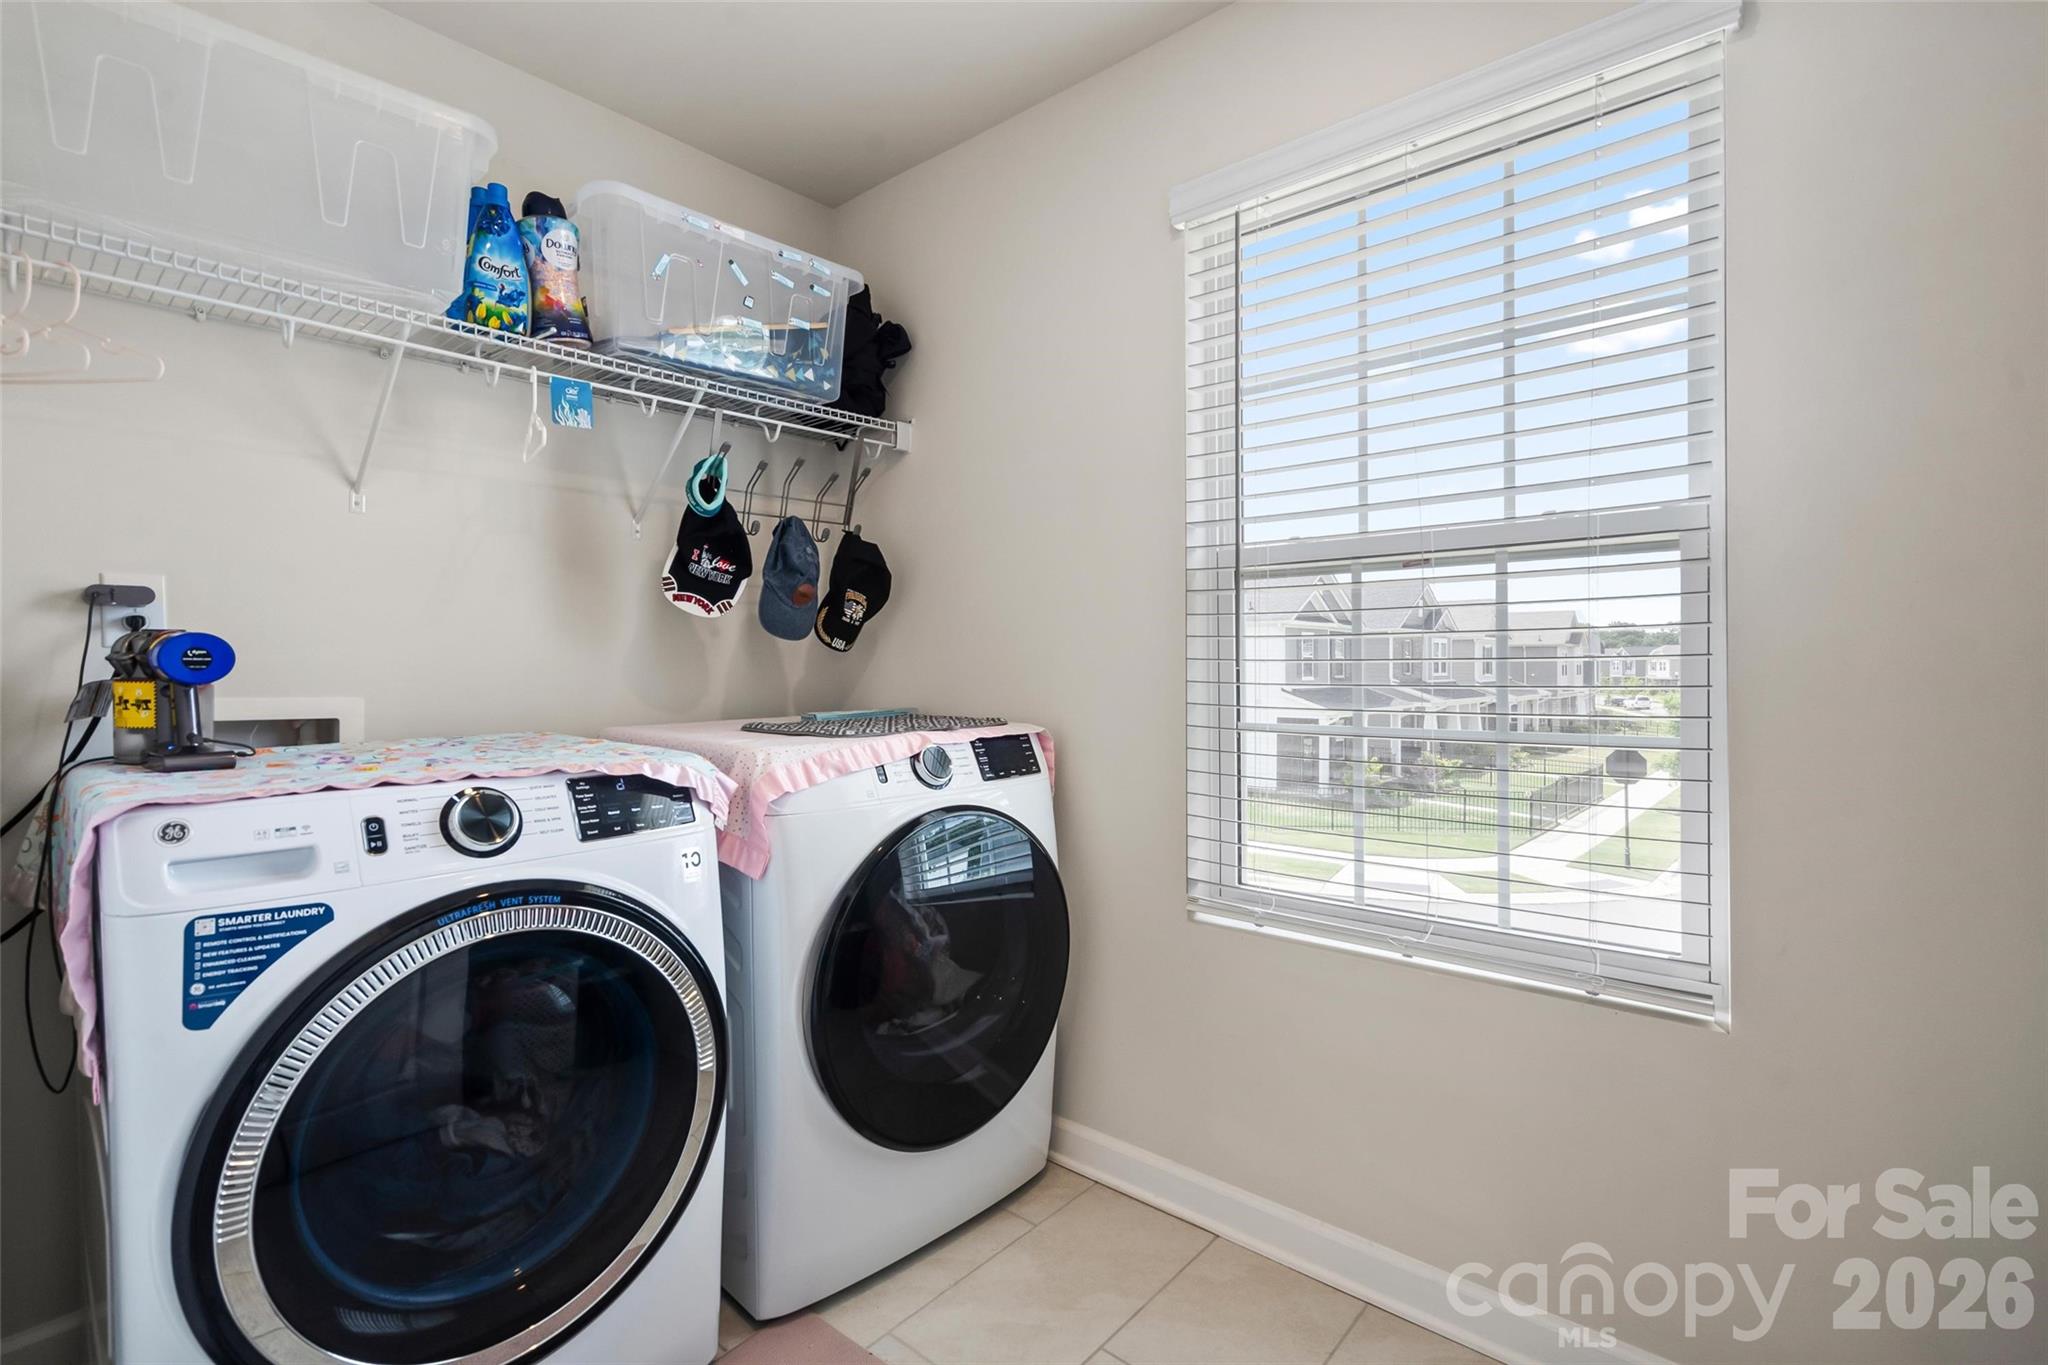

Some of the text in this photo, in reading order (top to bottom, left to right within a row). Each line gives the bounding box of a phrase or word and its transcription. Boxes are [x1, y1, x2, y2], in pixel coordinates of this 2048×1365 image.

[478, 256, 521, 279] Comfort
[688, 562, 709, 579] NEW
[711, 556, 736, 572] love
[693, 597, 715, 615] YORK
[831, 636, 846, 651] USA
[218, 906, 326, 927] SMARTER LAUNDRY
[436, 895, 561, 926] ULTRAFRESH VENT SYSTEM
[203, 939, 227, 948] REMOTE
[228, 936, 257, 945] CONTROL
[263, 929, 307, 940] NOTIFICATIONS
[218, 947, 248, 956] FEATURES
[254, 943, 281, 951] UPDATES
[236, 954, 267, 963] CLEANING
[227, 965, 258, 974] TRACKING
